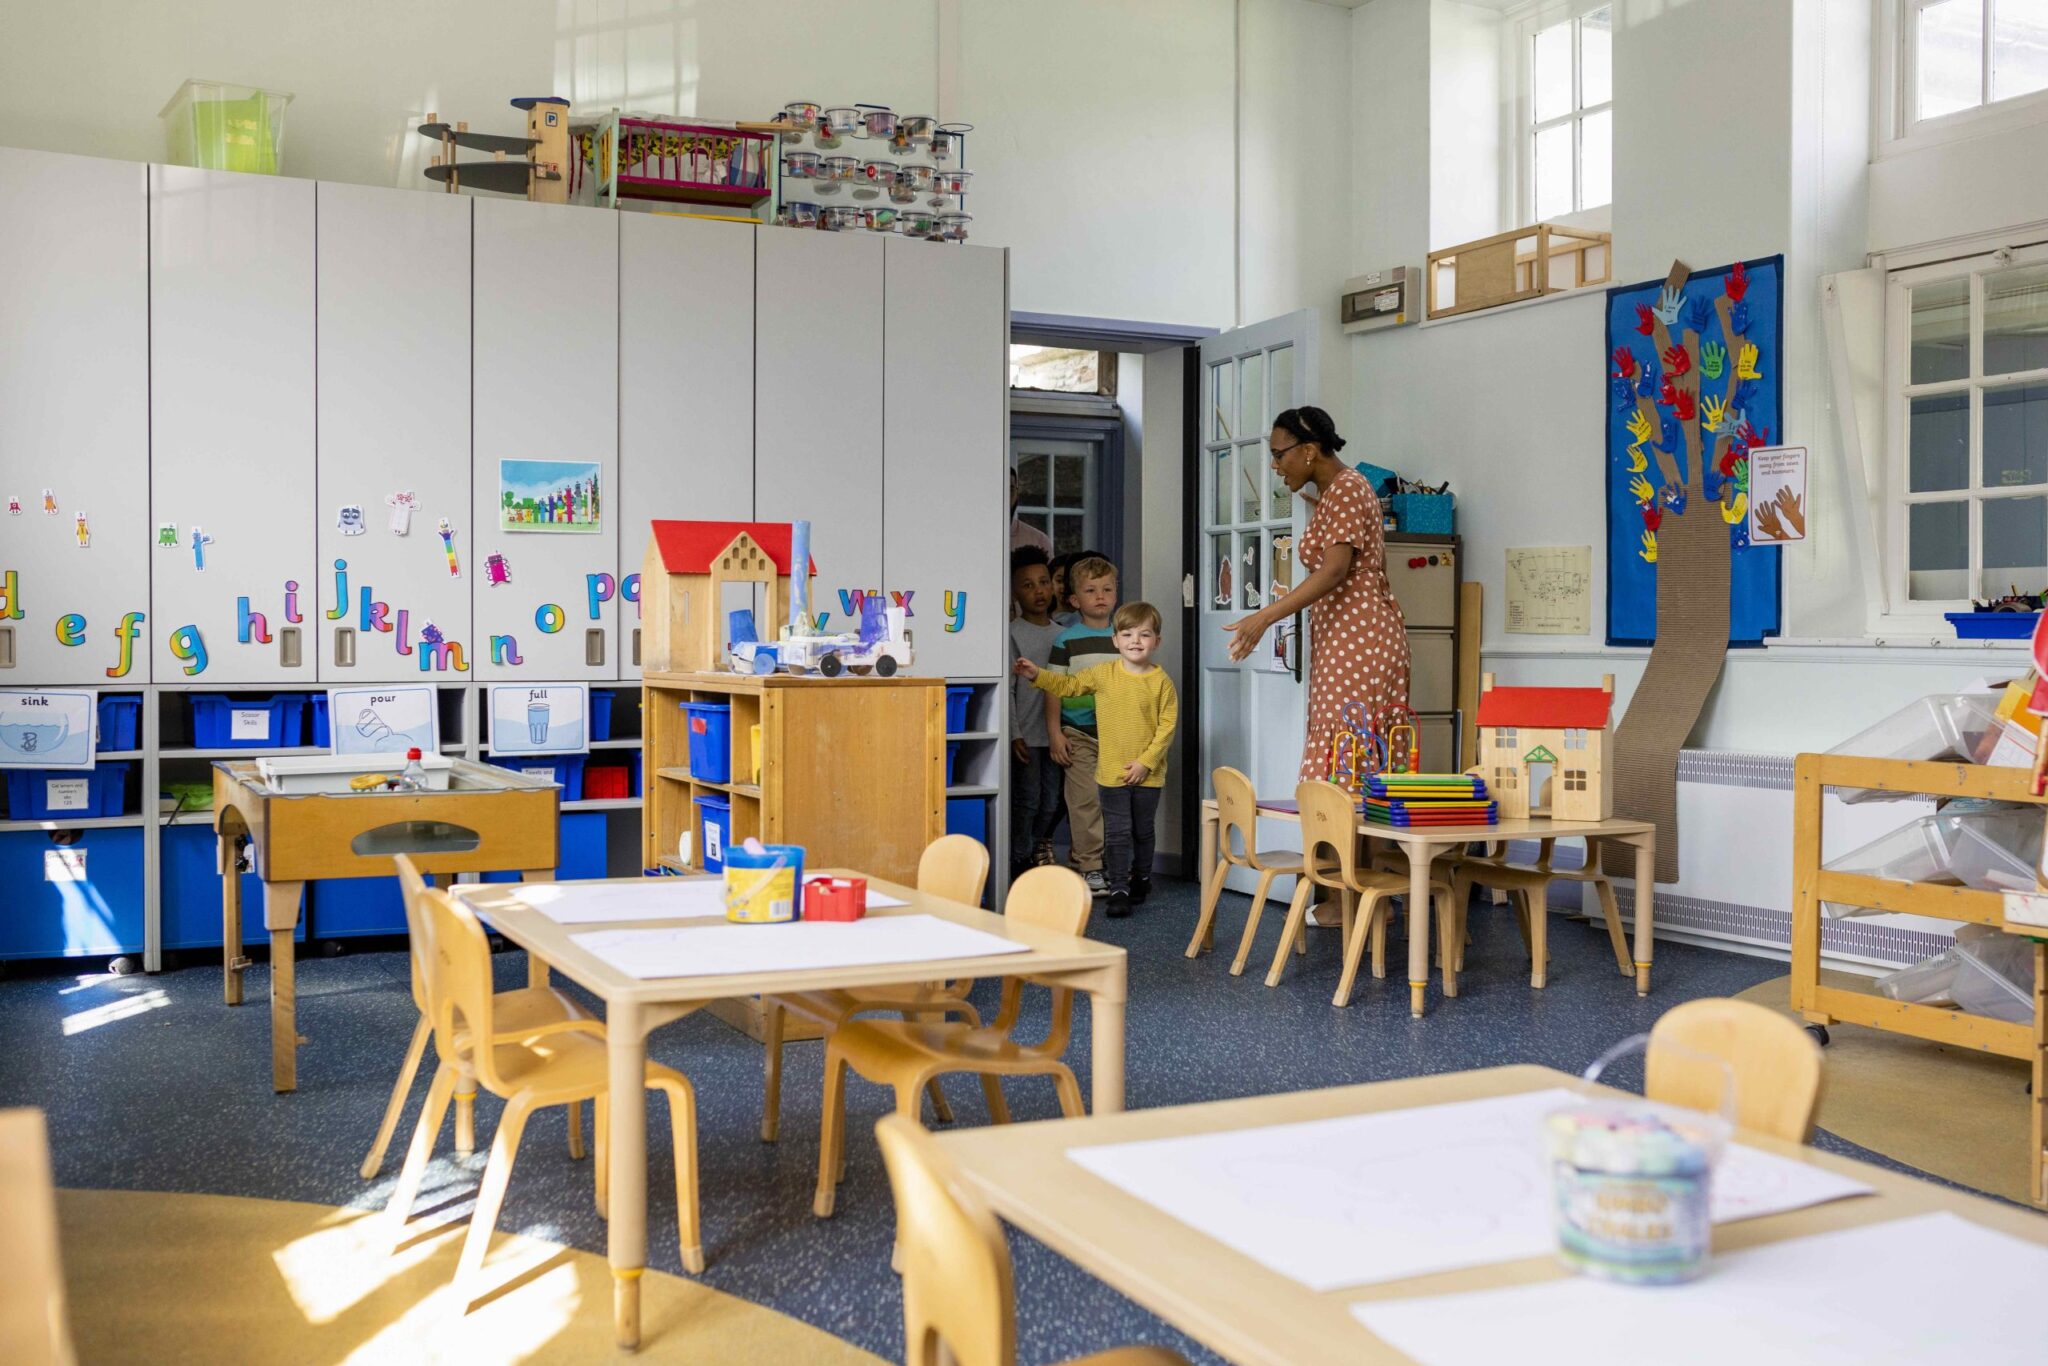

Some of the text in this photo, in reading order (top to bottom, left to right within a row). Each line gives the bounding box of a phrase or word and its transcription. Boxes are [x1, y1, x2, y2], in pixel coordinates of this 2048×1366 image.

[548, 115, 556, 124] P
[0, 571, 25, 620] d
[55, 613, 87, 646] e
[106, 611, 145, 678] f
[169, 624, 209, 676] g
[237, 596, 273, 644] h
[285, 580, 303, 623] i
[326, 558, 349, 620] j
[360, 586, 393, 633] k
[396, 609, 413, 656] l
[418, 641, 469, 672] m
[490, 635, 523, 666] n
[535, 603, 565, 634] o
[586, 572, 615, 620] p
[621, 573, 641, 620] q
[838, 589, 878, 616] w
[890, 590, 915, 617] x
[944, 590, 967, 633] y
[21, 696, 49, 706] sink
[370, 695, 396, 706] pour
[528, 689, 548, 702] full
